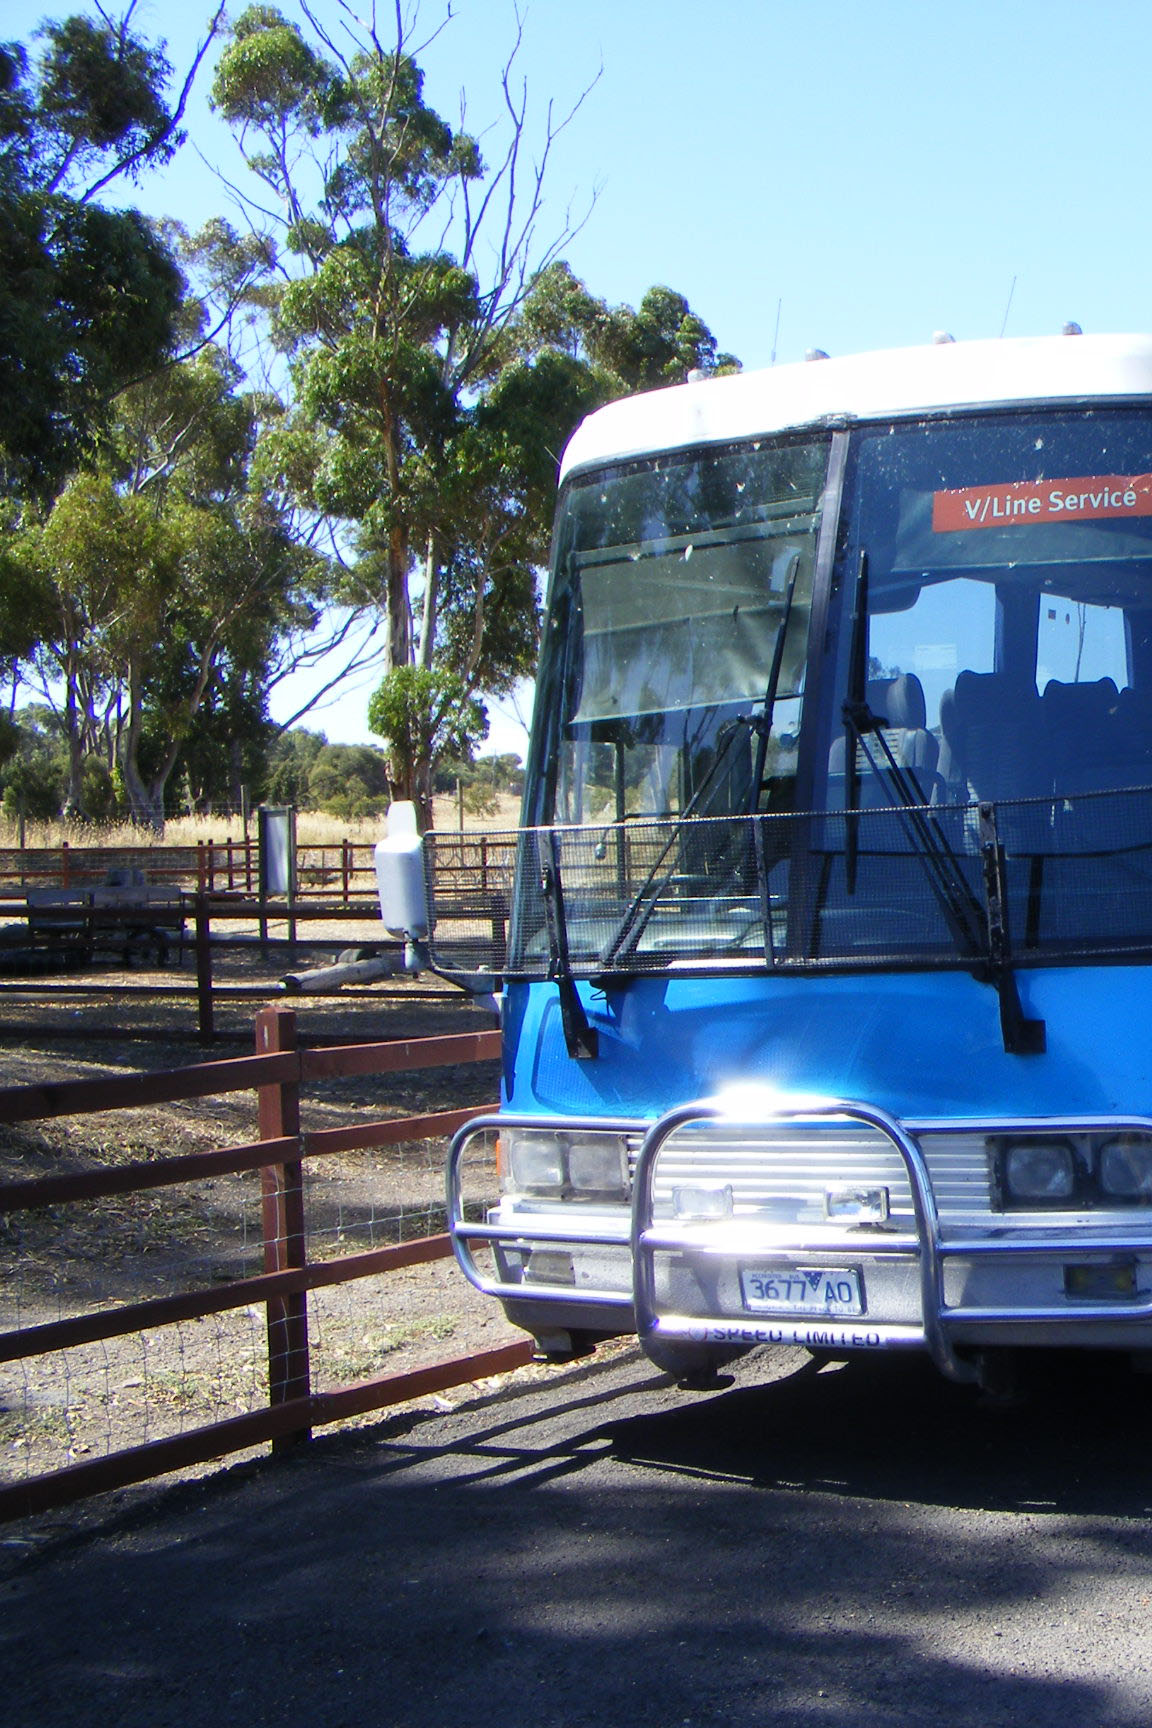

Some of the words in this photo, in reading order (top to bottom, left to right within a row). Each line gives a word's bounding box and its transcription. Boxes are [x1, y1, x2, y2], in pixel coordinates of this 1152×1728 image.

[965, 496, 1042, 522] V/Line
[1048, 487, 1137, 512] Service
[750, 1279, 807, 1301] 3677
[825, 1281, 852, 1303] AO
[714, 1327, 783, 1342] SPEED
[794, 1330, 880, 1347] LIMITED
